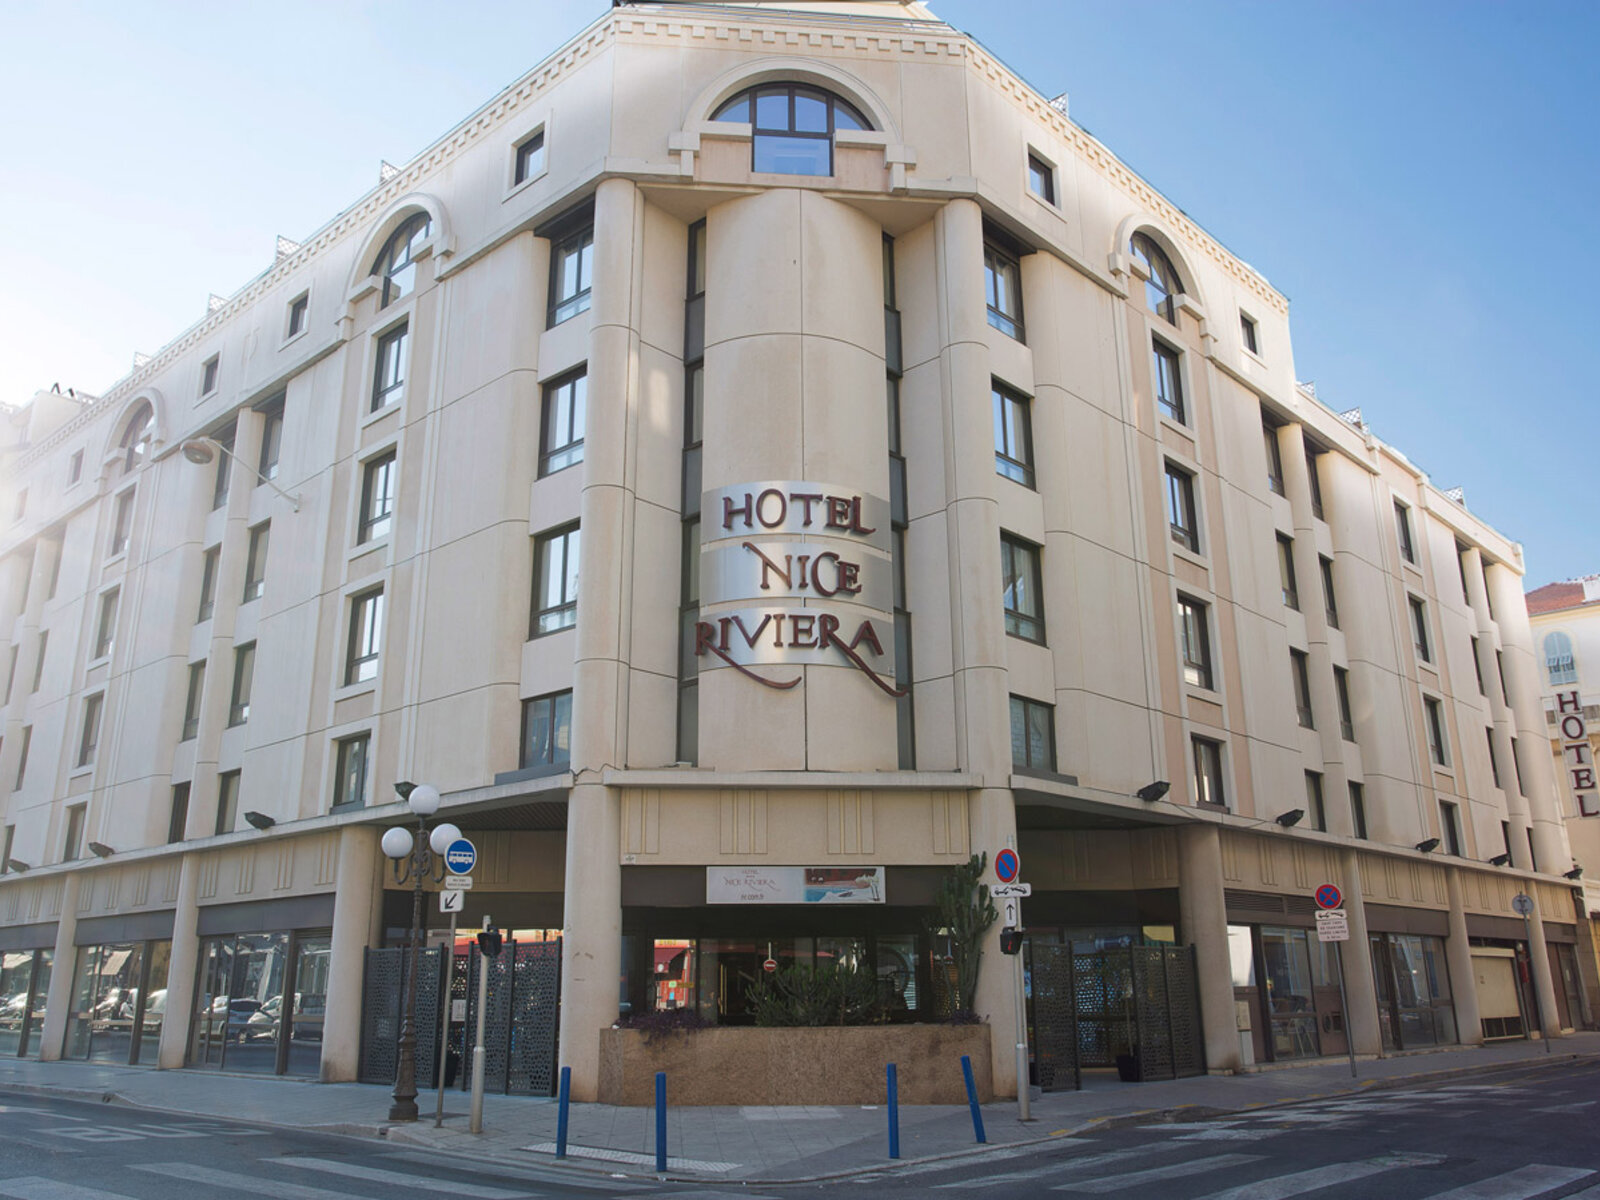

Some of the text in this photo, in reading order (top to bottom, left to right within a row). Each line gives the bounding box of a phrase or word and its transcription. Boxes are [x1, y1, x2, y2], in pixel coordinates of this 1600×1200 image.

[722, 488, 876, 534] HOTEL
[742, 541, 862, 597] NICE
[694, 613, 910, 697] RIVIERA
[1556, 690, 1600, 817] HOTEL
